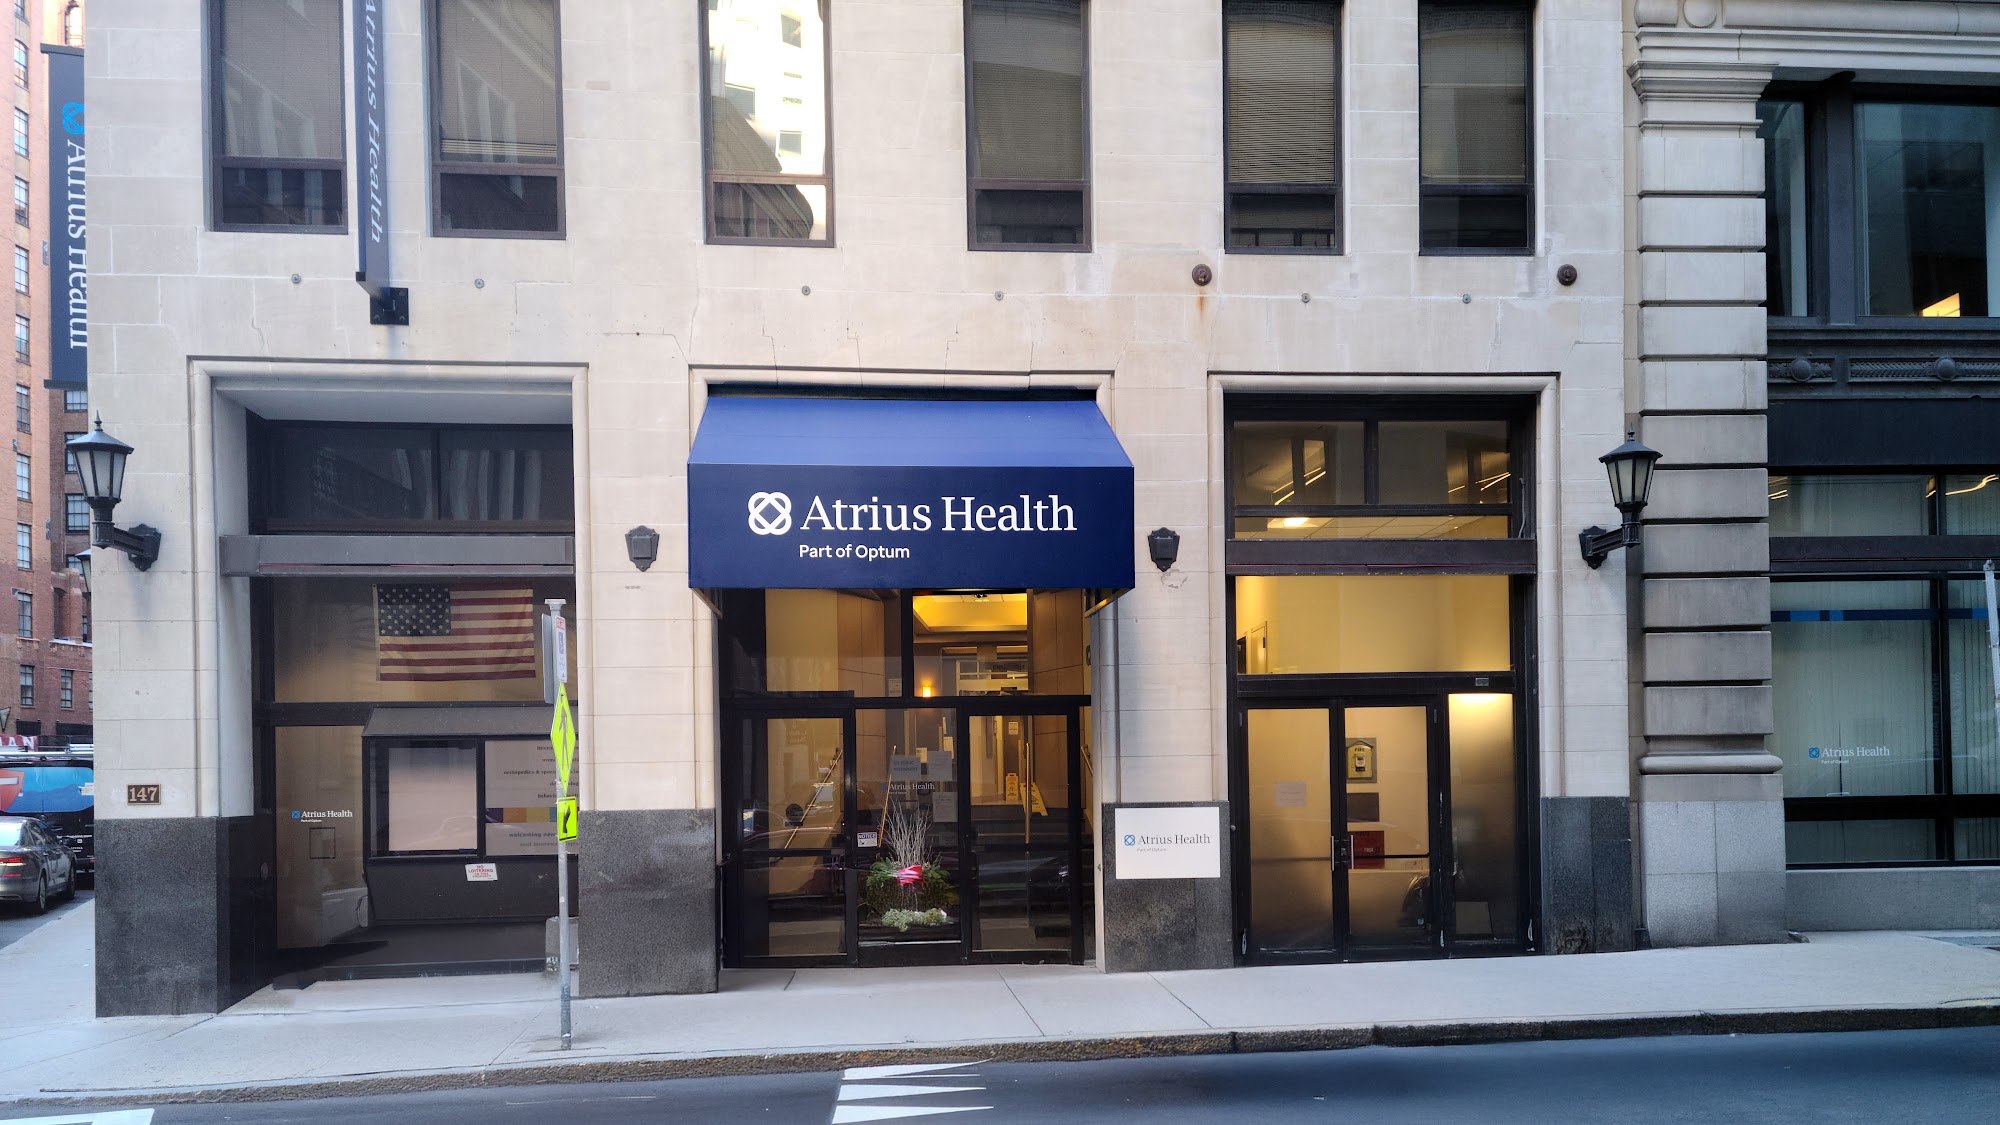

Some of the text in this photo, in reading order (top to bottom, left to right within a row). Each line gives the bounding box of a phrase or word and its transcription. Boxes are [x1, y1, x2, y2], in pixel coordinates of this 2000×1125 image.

[368, 112, 383, 243] Health
[800, 494, 1077, 531] Atrius Health
[799, 544, 910, 561] Part of Optum
[0, 736, 35, 750] AN
[1821, 746, 1890, 758] Atrius Health
[130, 787, 158, 801] 147
[327, 810, 353, 818] Health
[1138, 834, 1211, 845] Atrius Health
